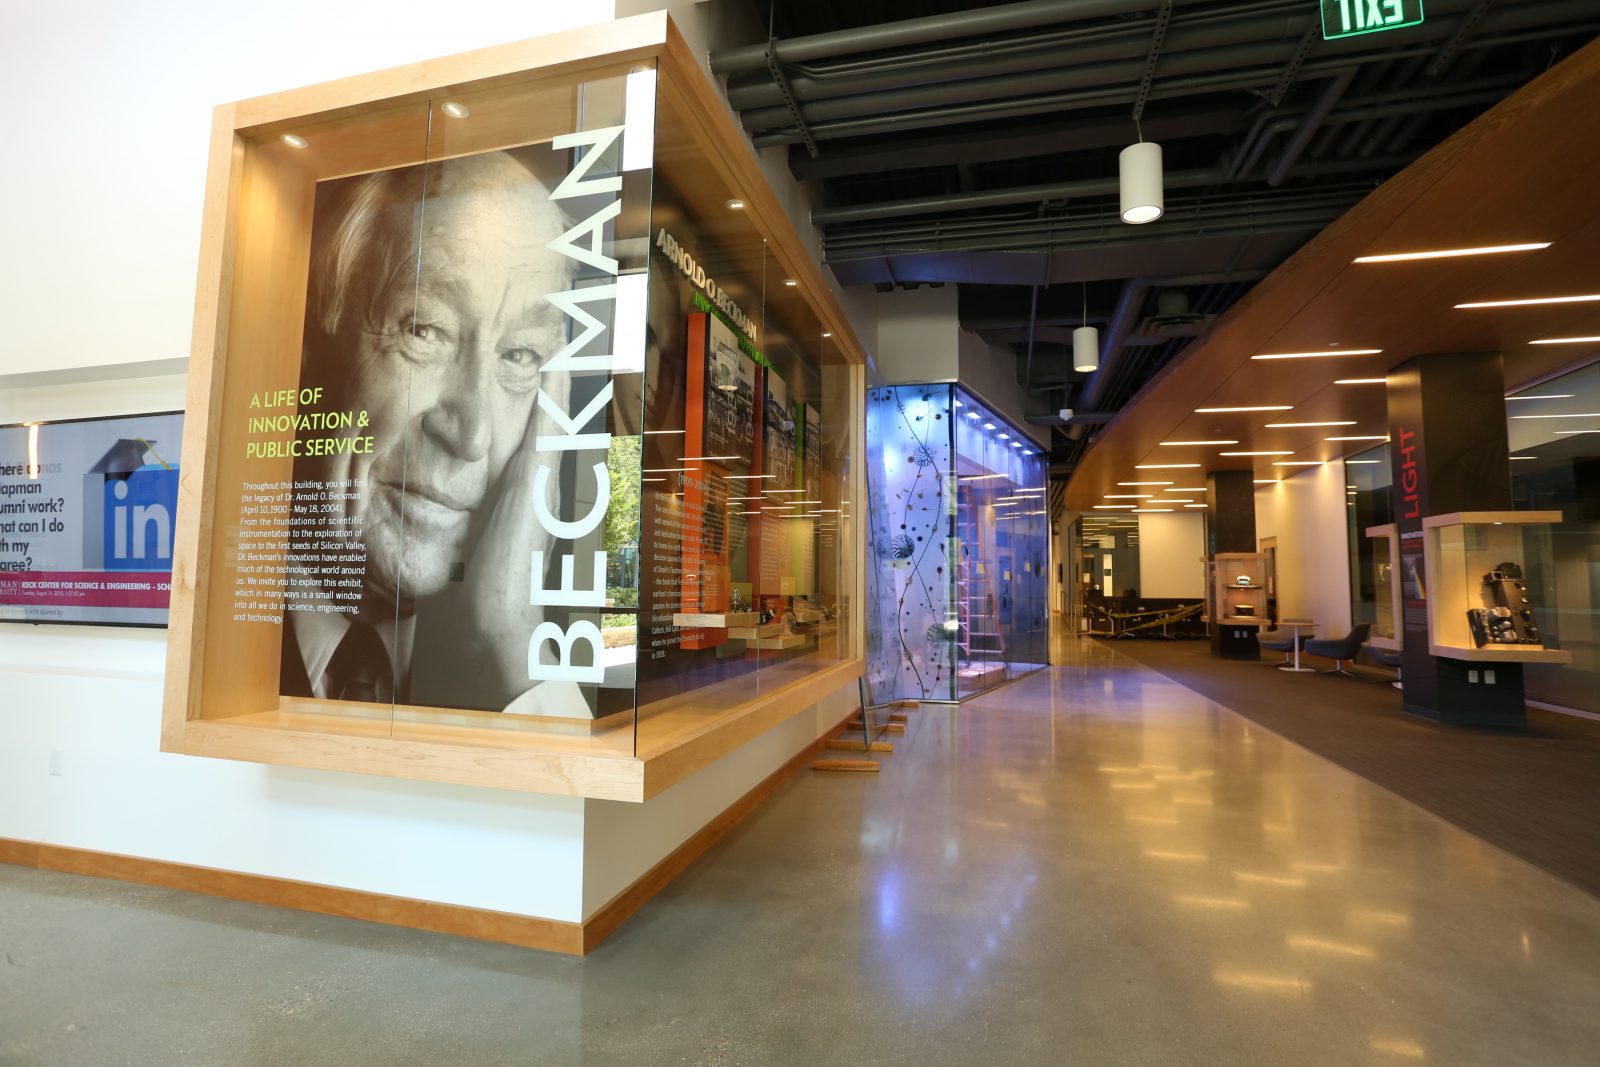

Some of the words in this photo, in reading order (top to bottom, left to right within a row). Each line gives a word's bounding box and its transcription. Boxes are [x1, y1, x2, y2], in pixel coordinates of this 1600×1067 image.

[656, 228, 706, 289] ARNOLD
[716, 287, 757, 342] BECKMAN
[250, 393, 261, 409] A
[264, 389, 296, 408] LIFE
[299, 387, 323, 405] OF
[528, 124, 626, 683] BECKMAN
[248, 411, 353, 434] INNOVATION
[356, 410, 369, 428] &
[246, 439, 302, 459] PUBLIC
[305, 436, 375, 456] SERVICE
[1399, 427, 1419, 518] LIGHT
[243, 482, 279, 491] Throughout
[281, 481, 292, 489] this
[295, 480, 323, 490] building,
[326, 481, 338, 489] you
[339, 479, 351, 488] will
[242, 494, 252, 502] the
[254, 494, 274, 503] legacy
[285, 493, 295, 501] Dr.
[296, 492, 318, 500] Arnold
[329, 492, 360, 500] Beckman
[28, 497, 64, 513] work?
[241, 505, 258, 515] (April
[270, 505, 287, 513] 1900
[294, 505, 308, 514] May
[309, 504, 319, 513] 18,
[18, 522, 39, 533] can
[42, 518, 46, 532] I
[49, 517, 64, 532] do
[114, 480, 170, 559] in
[274, 517, 315, 525] foundations
[328, 516, 363, 525] scientific
[240, 530, 290, 538] instrumentation
[314, 530, 352, 539] exploration
[355, 529, 362, 537] of
[12, 541, 29, 556] my
[238, 543, 256, 551] space
[278, 541, 290, 549] first
[312, 541, 319, 549] of
[320, 541, 343, 549] Silicon
[345, 541, 366, 551] Valley,
[238, 553, 246, 561] Dr.
[248, 553, 281, 561] Beckman's
[284, 553, 320, 561] innovations
[339, 554, 366, 562] enabled
[237, 565, 254, 573] much
[277, 566, 320, 575] technological
[321, 566, 339, 574] world
[341, 566, 365, 575] around
[22, 581, 37, 589] KECK
[74, 582, 99, 590] SCIENCE
[107, 582, 151, 590] ENGINEERING
[247, 577, 257, 585] We
[259, 577, 275, 585] invite
[277, 579, 289, 587] you
[290, 578, 297, 586] to
[298, 578, 322, 587] explore
[324, 578, 337, 586] this
[338, 579, 363, 589] exhibit,
[235, 589, 254, 597] which
[264, 591, 282, 599] many
[284, 591, 299, 600] ways
[315, 591, 334, 599] small
[336, 591, 362, 600] window
[235, 601, 247, 609] into
[270, 602, 277, 610] do
[280, 602, 286, 610] in
[288, 602, 315, 612] science,
[317, 604, 360, 614] engineering,
[233, 613, 246, 621] and
